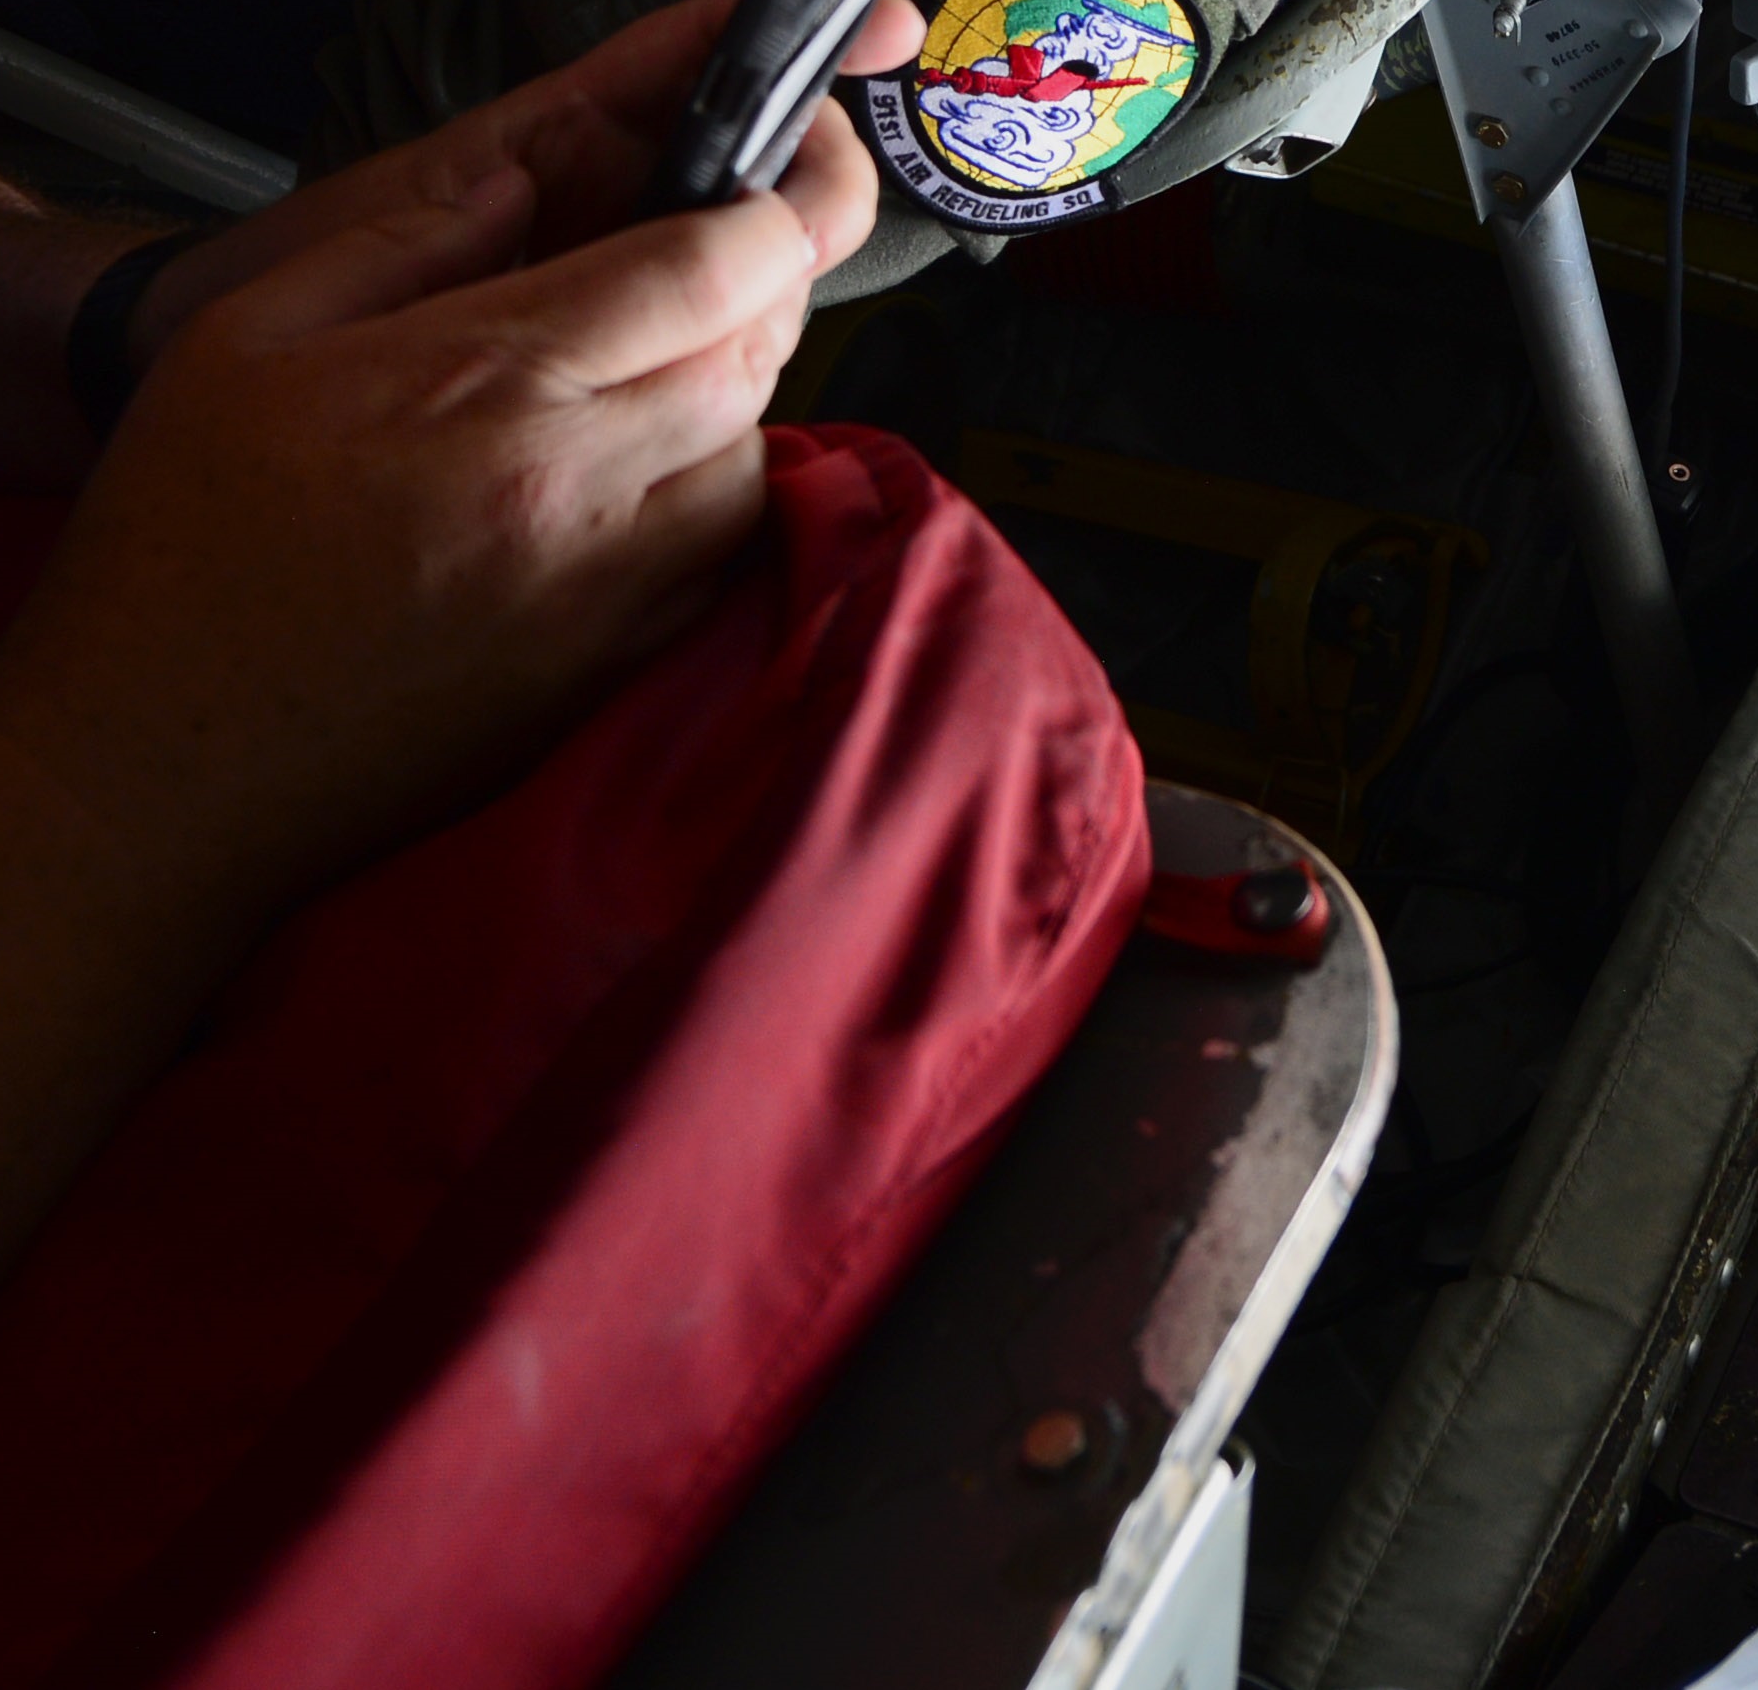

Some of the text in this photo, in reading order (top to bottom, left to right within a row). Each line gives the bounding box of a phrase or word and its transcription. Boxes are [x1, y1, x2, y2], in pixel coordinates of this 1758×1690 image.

[873, 94, 1093, 222] 91ST AIR REFUELING SQ
